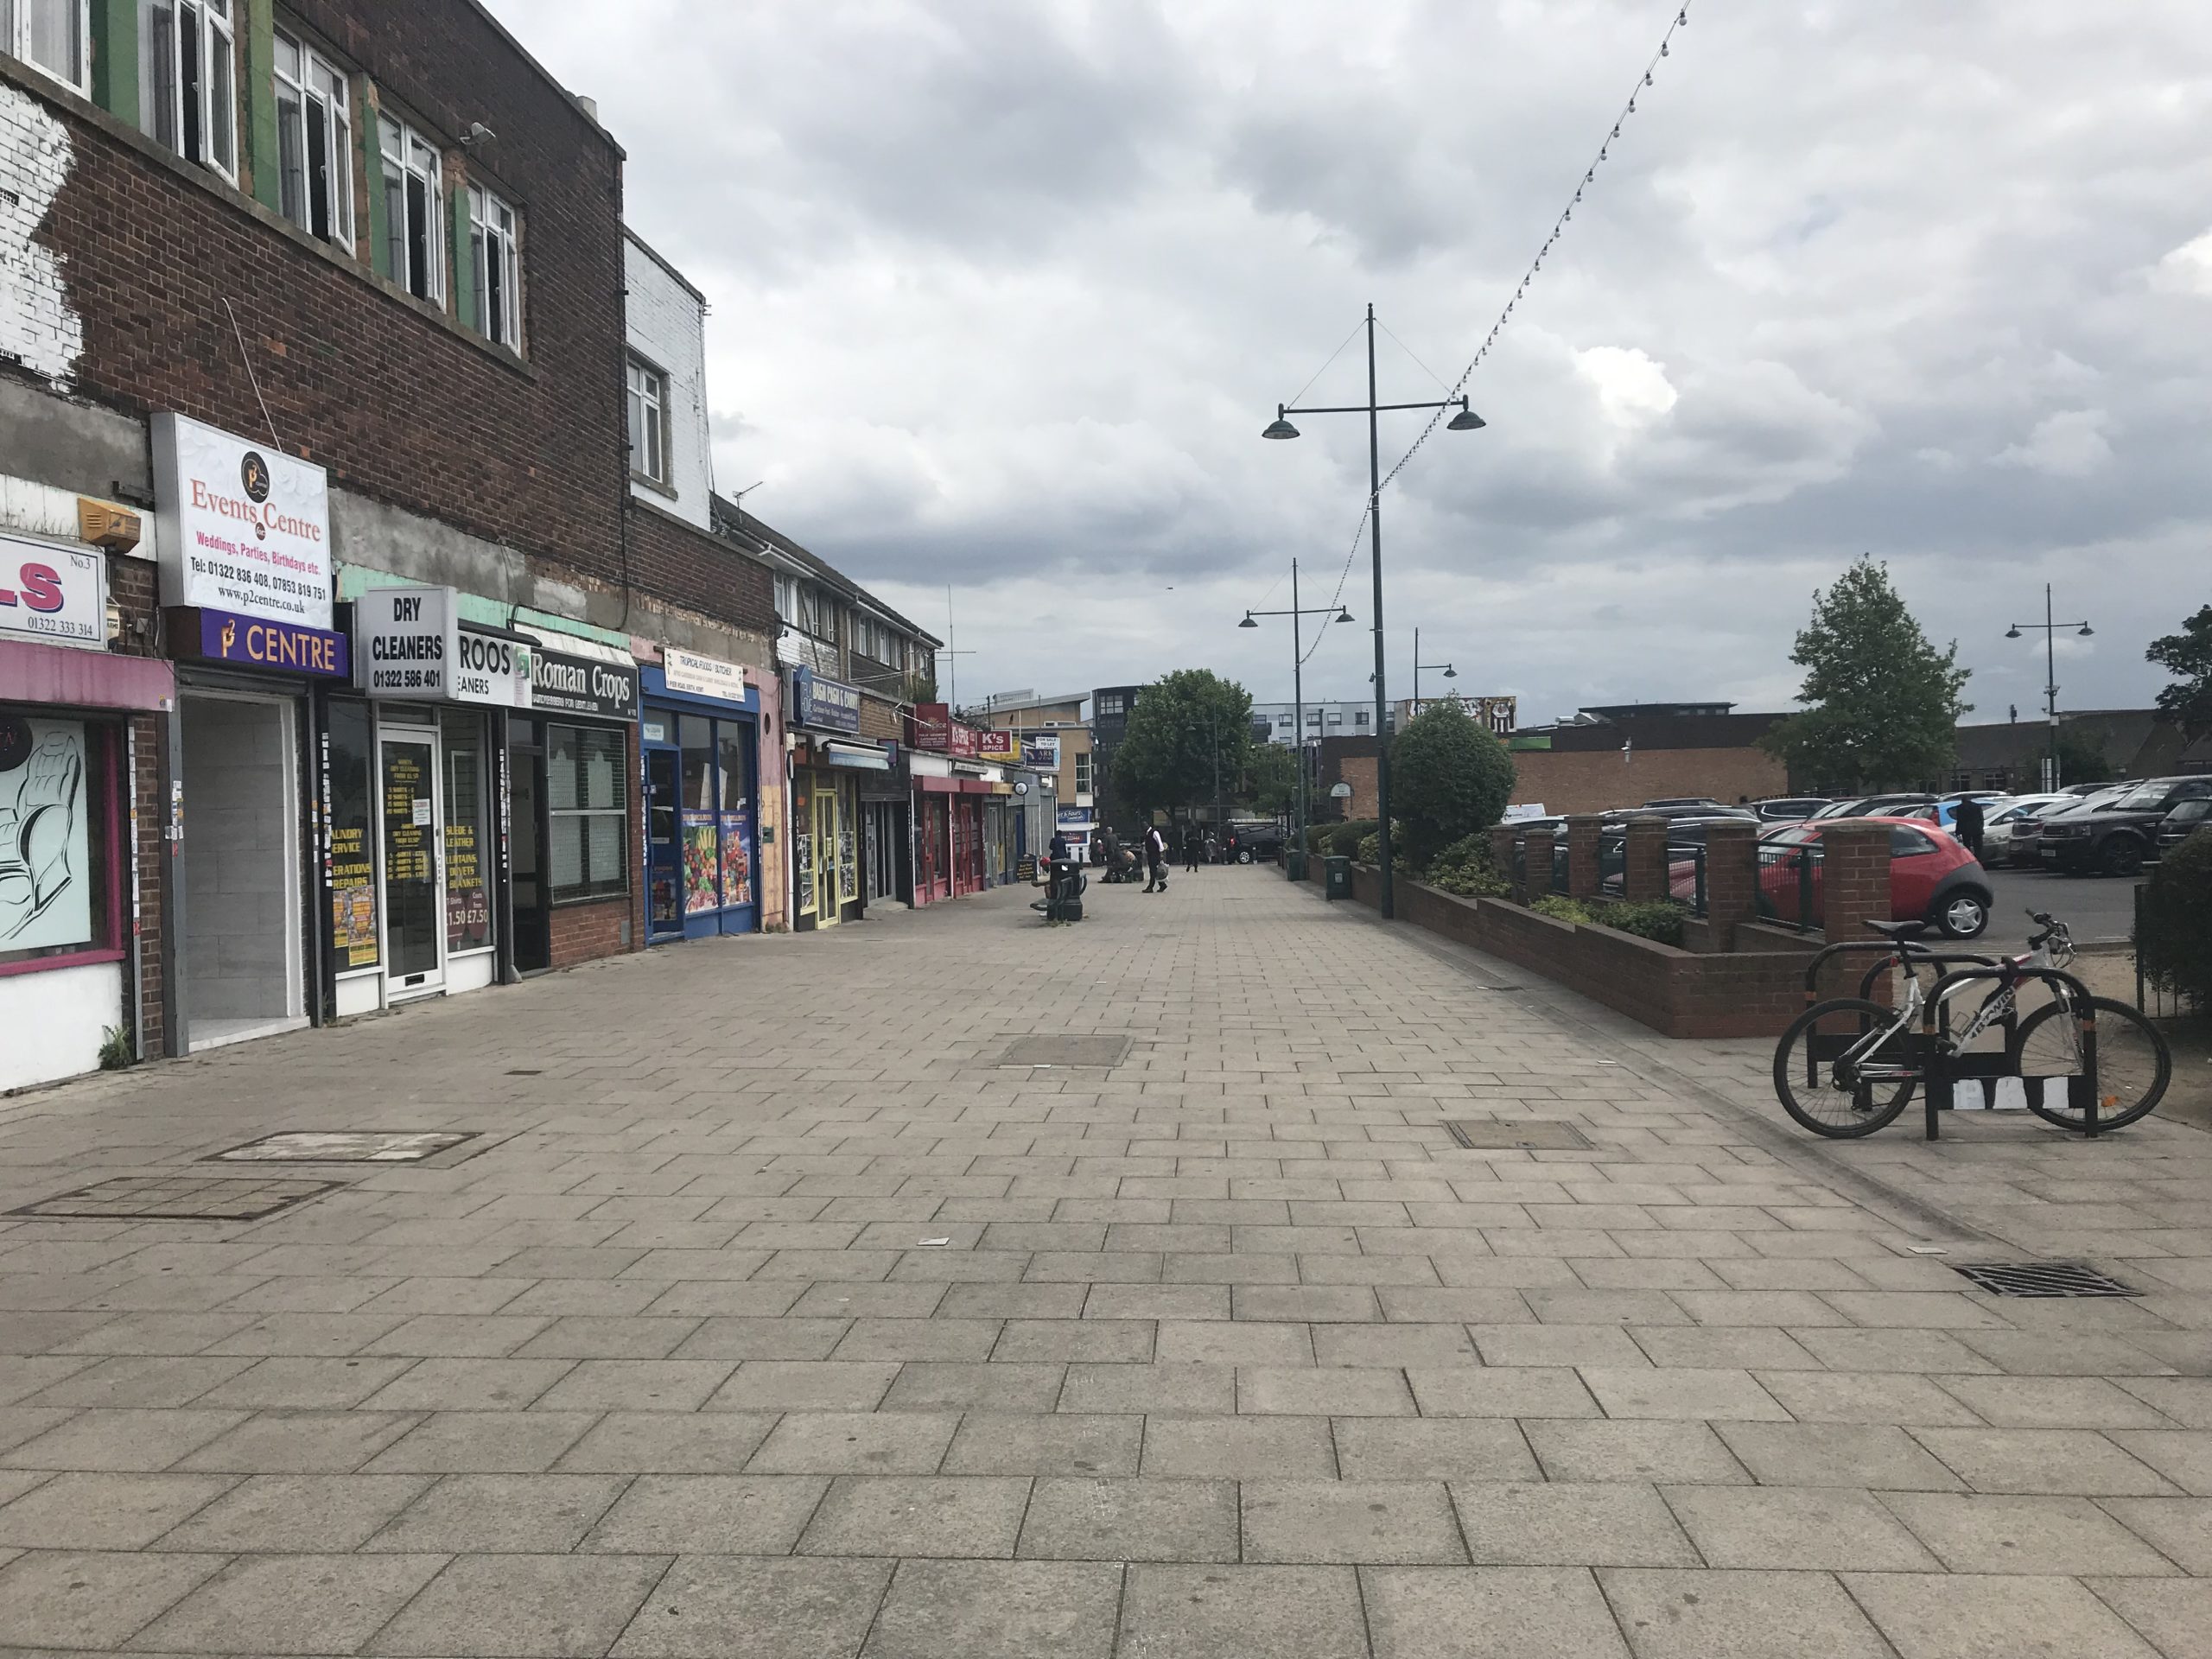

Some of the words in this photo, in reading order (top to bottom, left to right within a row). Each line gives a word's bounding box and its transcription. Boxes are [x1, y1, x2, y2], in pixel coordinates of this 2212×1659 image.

[190, 479, 257, 524] Events
[263, 502, 321, 542] Centre
[70, 555, 91, 569] No.3
[196, 531, 238, 556] Weddings,
[240, 543, 270, 565] Parties,
[272, 551, 306, 574] Birthdays
[308, 563, 321, 575] etc.
[0, 563, 64, 613] S
[190, 556, 207, 573] Tel:
[208, 561, 234, 580] 01322
[237, 568, 251, 583] 836
[254, 573, 271, 590] 408,
[272, 576, 296, 594] 07853
[297, 583, 311, 598] 819
[314, 586, 326, 601] 751
[219, 587, 305, 613] www.p2centre.co.uk
[393, 597, 422, 621] DRY
[28, 616, 56, 632] 01322
[60, 620, 75, 634] 333
[79, 623, 92, 636] 314
[246, 624, 335, 671] CENTRE
[372, 635, 442, 660] CLEANERS
[459, 635, 511, 676] ROOS
[373, 671, 402, 688] 01322
[404, 671, 422, 687] 586
[423, 670, 441, 687] 401
[531, 652, 588, 695] Roman
[593, 665, 630, 709] Crops
[565, 697, 575, 709] FOR
[982, 733, 1004, 744] K's
[446, 825, 467, 835] SUEDE
[446, 837, 474, 847] LEATHER
[449, 866, 475, 876] DUVETS
[333, 877, 368, 889] REPAIRS
[449, 877, 483, 889] BLANKETS
[446, 910, 466, 925] 1.50
[467, 909, 488, 924] £7.50
